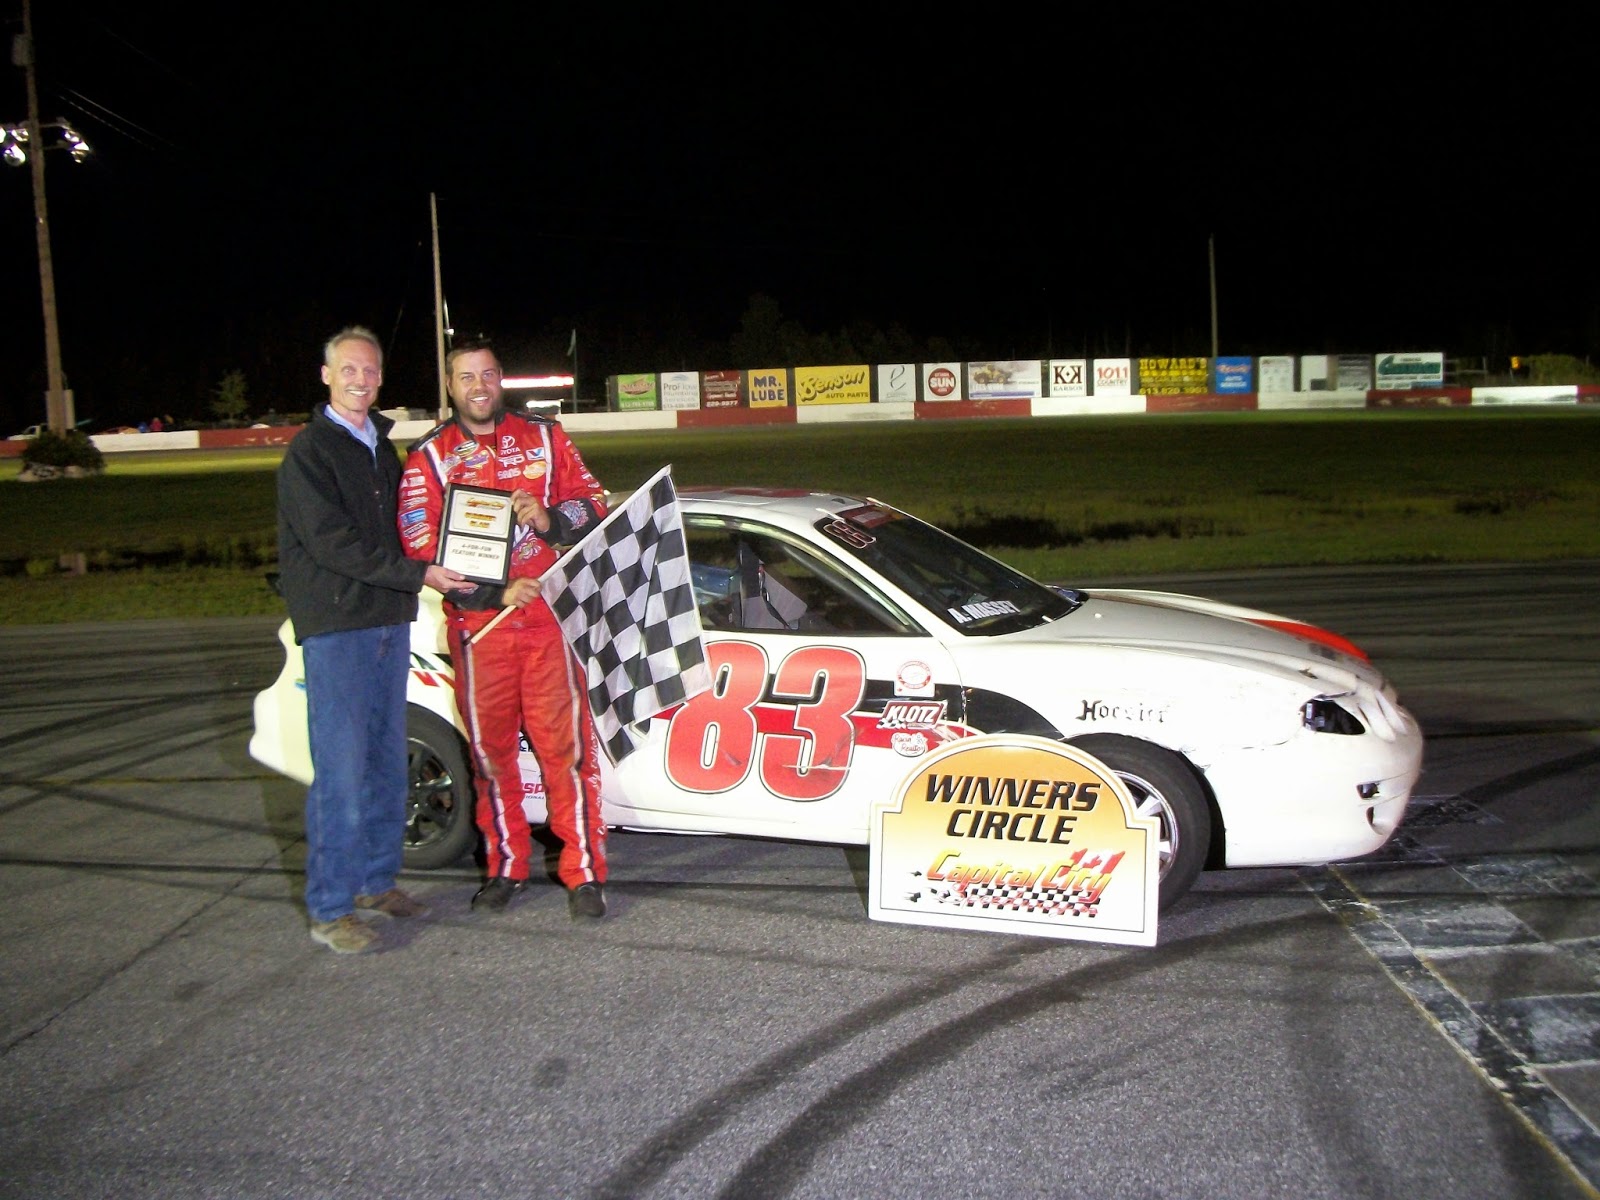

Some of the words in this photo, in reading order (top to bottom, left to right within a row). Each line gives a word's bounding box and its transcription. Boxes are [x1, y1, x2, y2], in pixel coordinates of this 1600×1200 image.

[753, 375, 782, 387] MR.
[798, 371, 866, 402] Benson
[930, 377, 955, 388] SUN
[751, 388, 785, 402] LUBE
[478, 552, 500, 560] WINNER
[961, 600, 1021, 620] MASSEY
[664, 640, 867, 802] 83
[885, 705, 940, 722] KLOTZ
[926, 774, 1101, 812] WINNERS
[946, 809, 1078, 844] CIRCLE
[926, 848, 1046, 898] Capital
[1041, 858, 1113, 904] City
